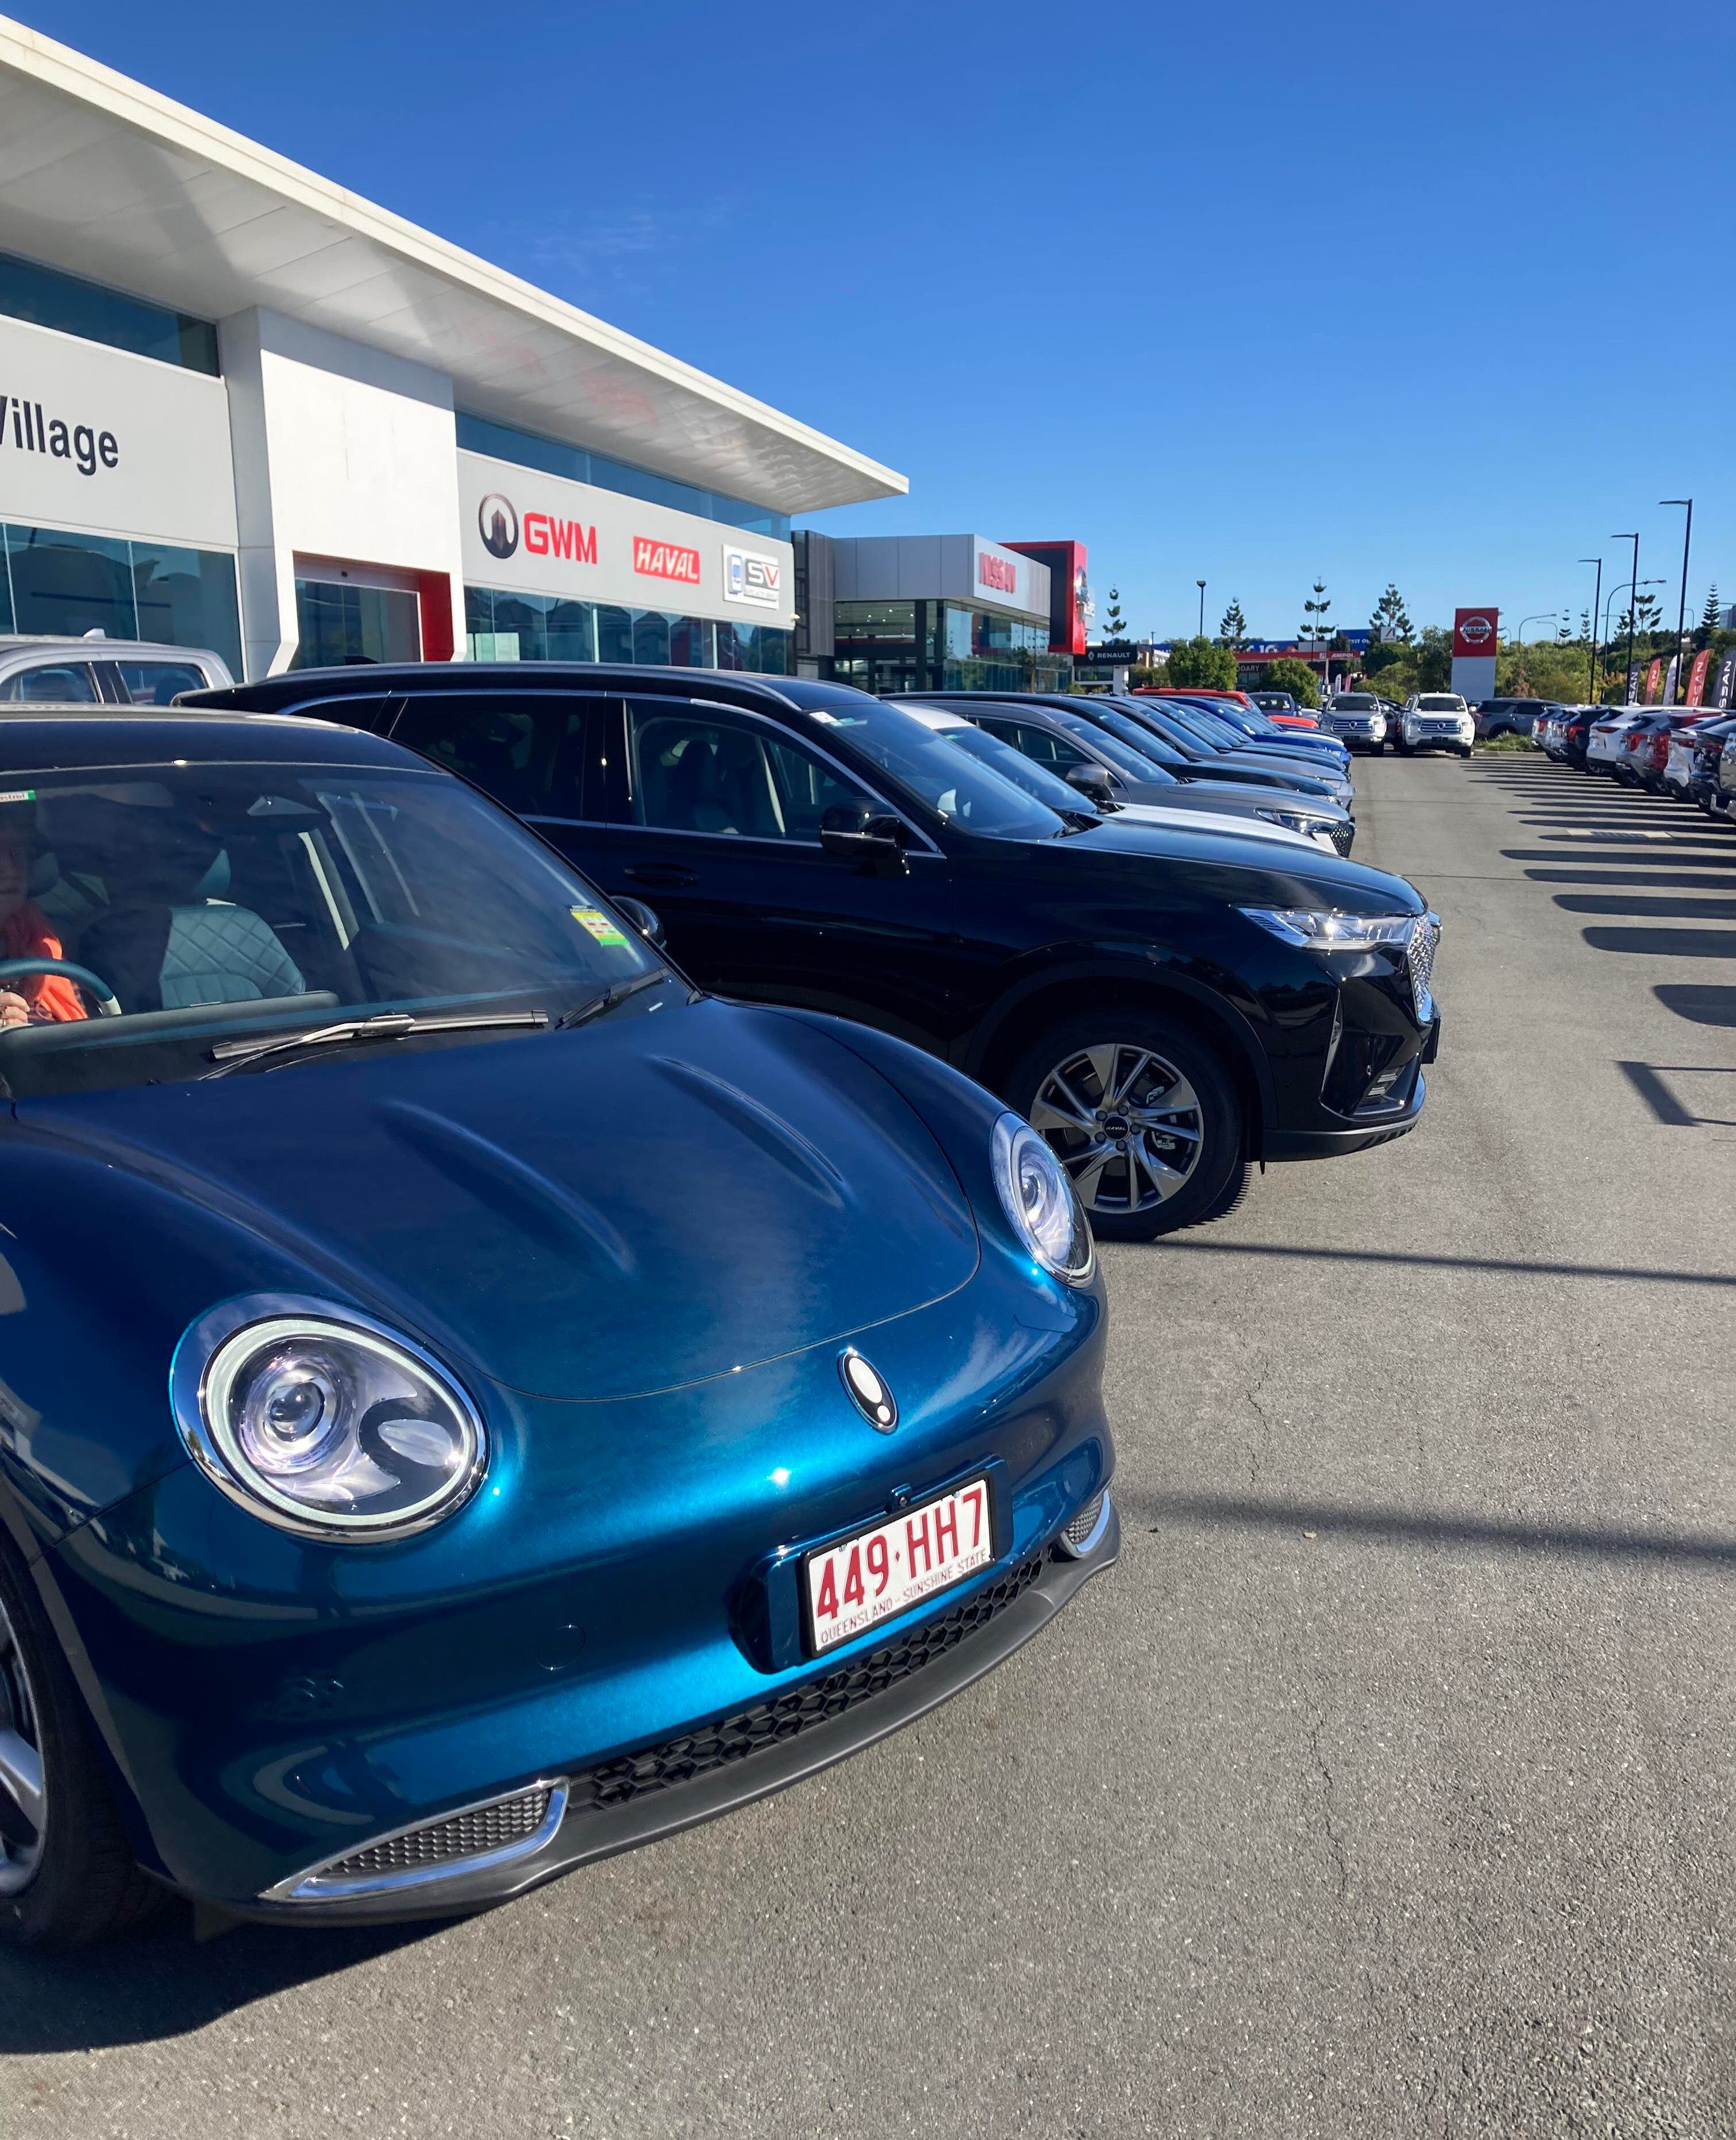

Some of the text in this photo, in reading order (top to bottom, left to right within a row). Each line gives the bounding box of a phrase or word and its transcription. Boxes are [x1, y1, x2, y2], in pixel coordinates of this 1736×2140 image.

[524, 511, 598, 564] GWM
[636, 542, 699, 582] HAVAL
[1719, 661, 1732, 708] SSAN
[821, 1596, 893, 1644] QUEENSLAND
[902, 1568, 953, 1603] SUNSHINE
[957, 1549, 986, 1575] STATE
